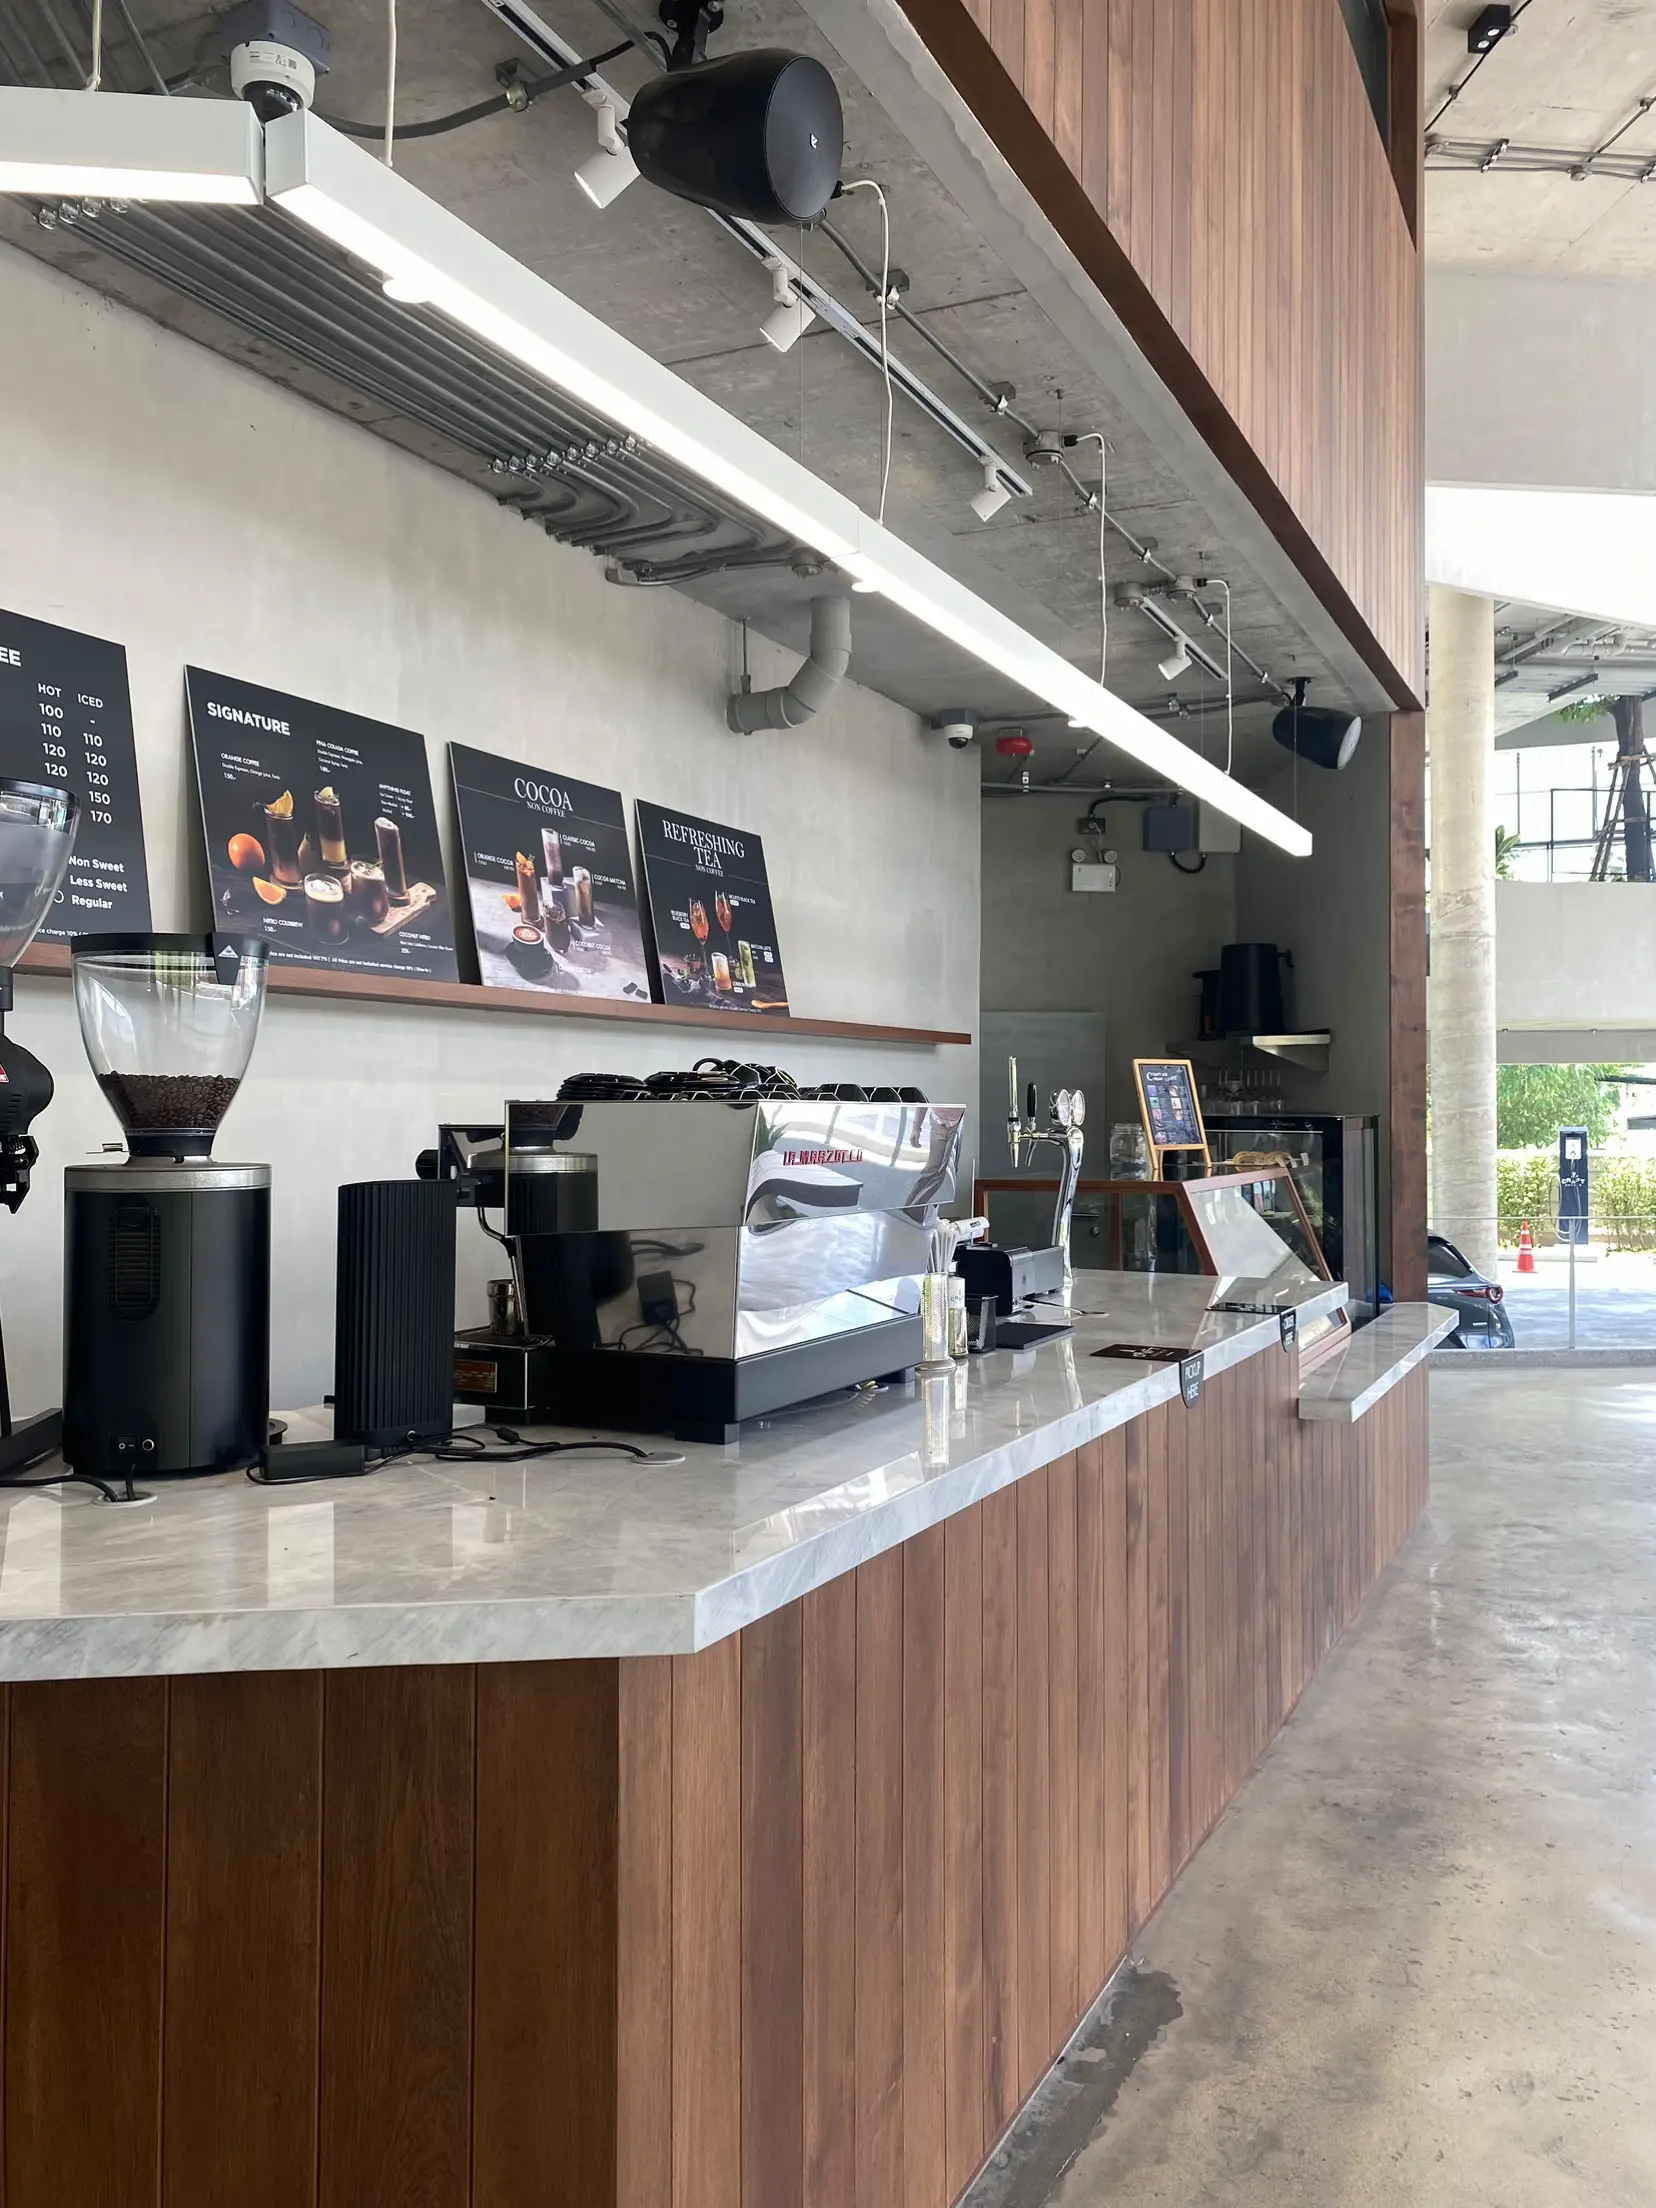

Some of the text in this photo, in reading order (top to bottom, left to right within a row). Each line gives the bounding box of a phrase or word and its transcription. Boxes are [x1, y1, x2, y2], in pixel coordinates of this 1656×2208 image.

[38, 683, 103, 708] HOT ICED
[39, 703, 63, 719] 100
[207, 702, 290, 736] SIGNATURE
[41, 723, 103, 747] 110 110
[43, 743, 107, 767] 120 120
[44, 763, 109, 786] 120 120
[89, 791, 110, 805] 150
[514, 777, 574, 812] COCOA
[90, 810, 112, 825] 170
[527, 801, 567, 818] NON COFFEE
[662, 820, 745, 858] REFRESHING
[69, 856, 125, 873] Non Sweet
[693, 846, 722, 869] TEA
[69, 875, 128, 892] Less Sweet
[71, 894, 113, 910] Regular
[46, 928, 68, 936] charge
[1187, 1381, 1198, 1401] HERE
